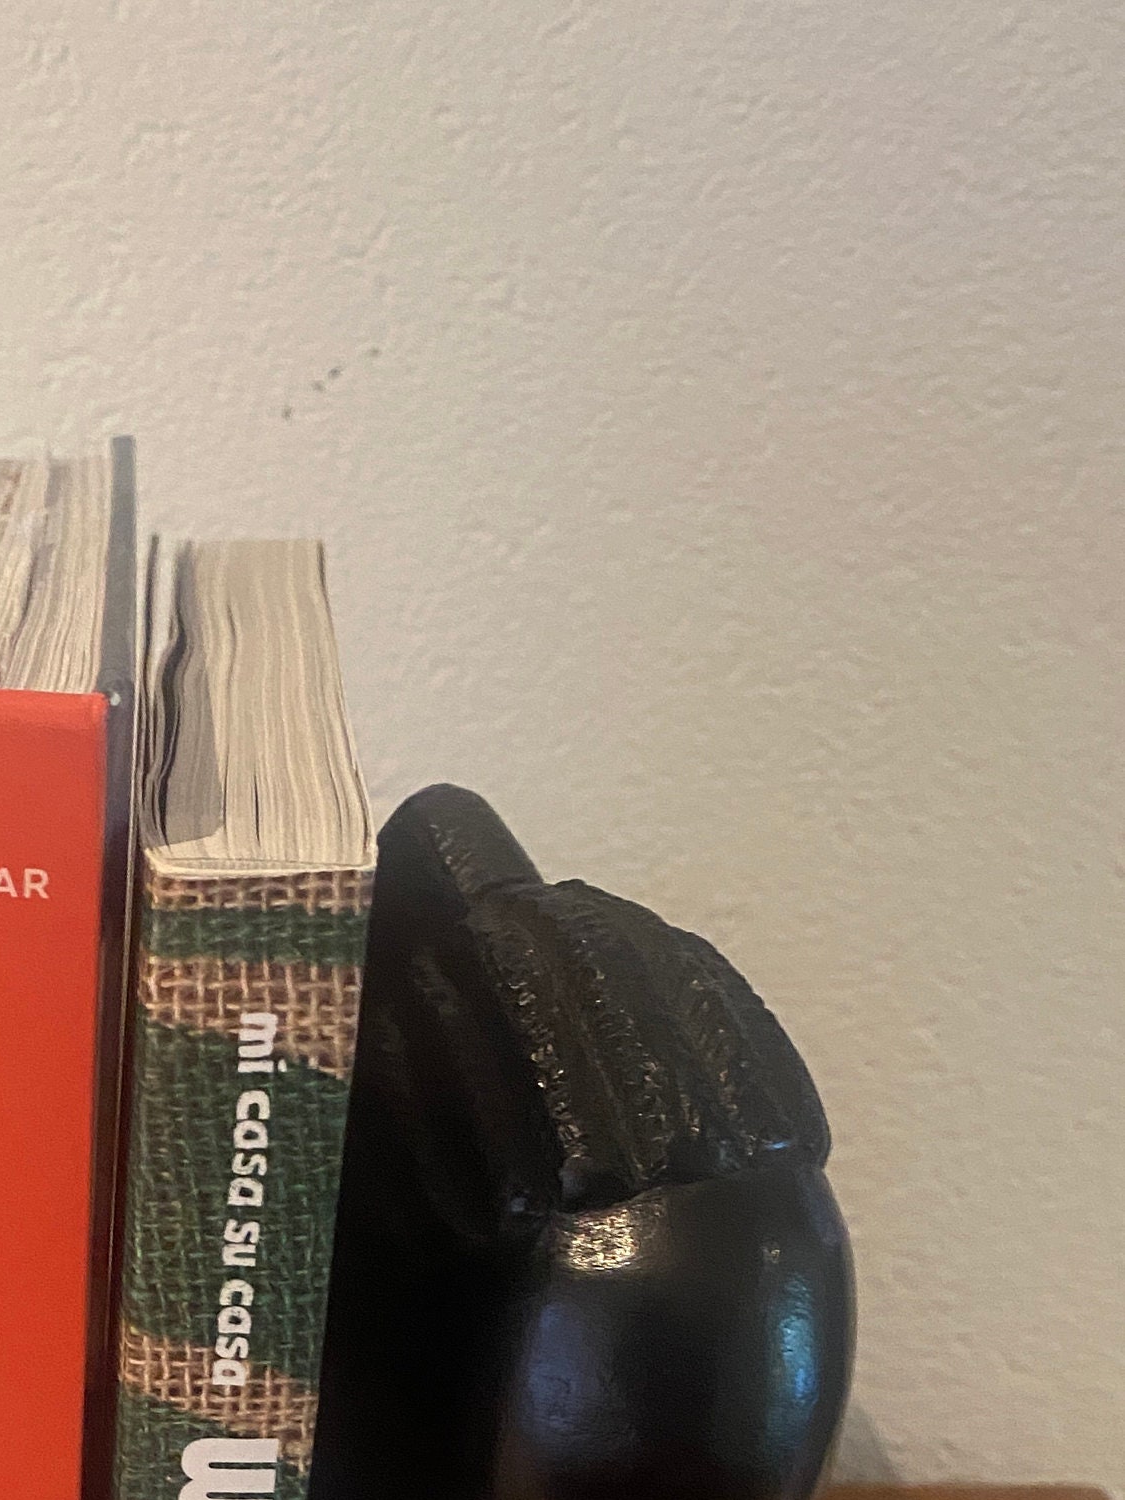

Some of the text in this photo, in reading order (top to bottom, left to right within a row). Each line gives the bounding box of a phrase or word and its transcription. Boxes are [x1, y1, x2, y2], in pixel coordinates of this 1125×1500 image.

[212, 1011, 288, 1387] mi casa su casa
